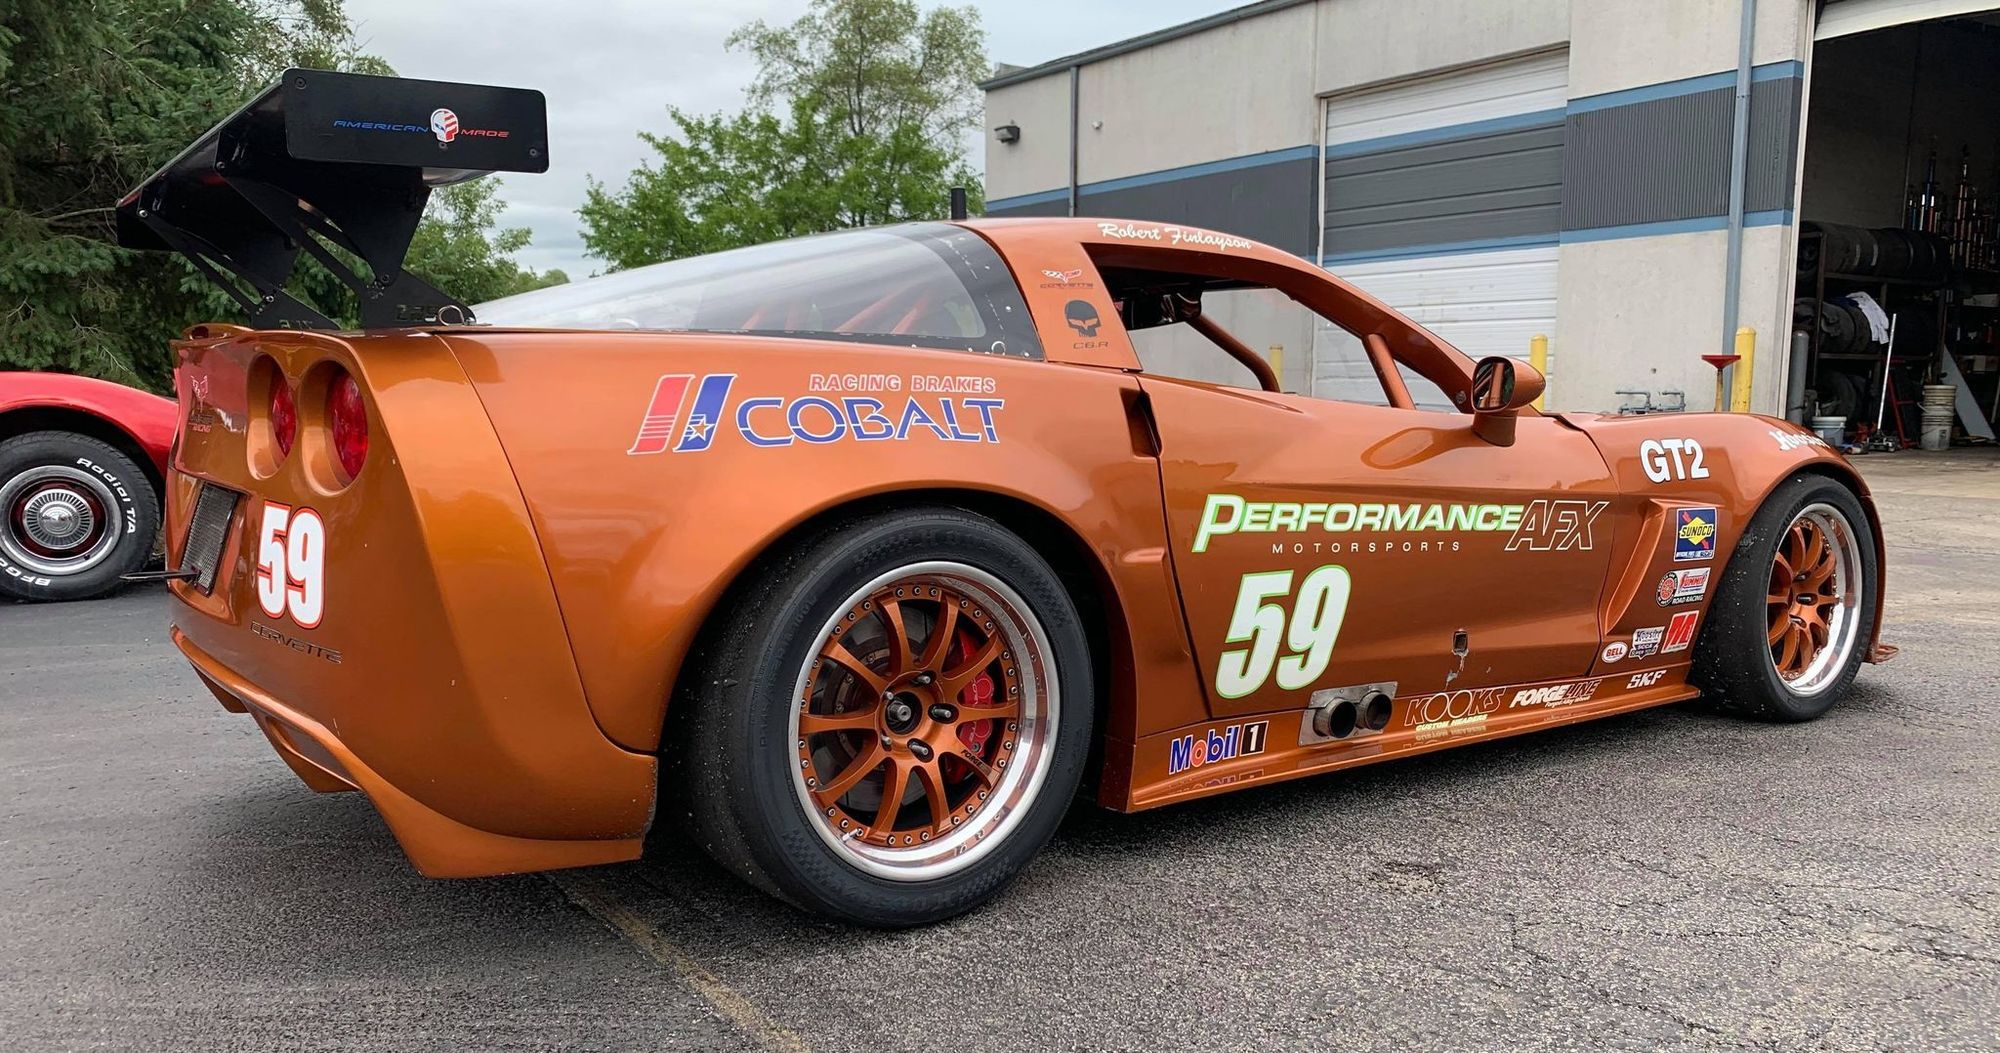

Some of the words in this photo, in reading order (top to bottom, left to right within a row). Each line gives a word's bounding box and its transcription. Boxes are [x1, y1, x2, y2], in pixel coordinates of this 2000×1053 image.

[333, 120, 429, 133] AMERICAN
[460, 128, 510, 138] MADE
[1097, 223, 1161, 241] Robert
[1164, 226, 1251, 250] Finlayson
[809, 374, 902, 392] RACING
[911, 375, 996, 393] BRAKES
[735, 397, 1004, 447] COBALT
[1640, 438, 1710, 484] GT2
[76, 457, 131, 502] Radial
[126, 507, 136, 534] T/A
[1192, 493, 1525, 553] PERFORMANCE
[1681, 525, 1712, 537] SUNOCO
[1272, 541, 1461, 554] MOTORSPORTS
[257, 500, 326, 630] 59
[1215, 565, 1352, 699] 59
[1606, 647, 1623, 657] BELL
[1509, 679, 1602, 708] FORGELINE
[1626, 670, 1667, 689] SKF
[1404, 688, 1506, 726] KOOKS
[1169, 725, 1240, 774] Mobil
